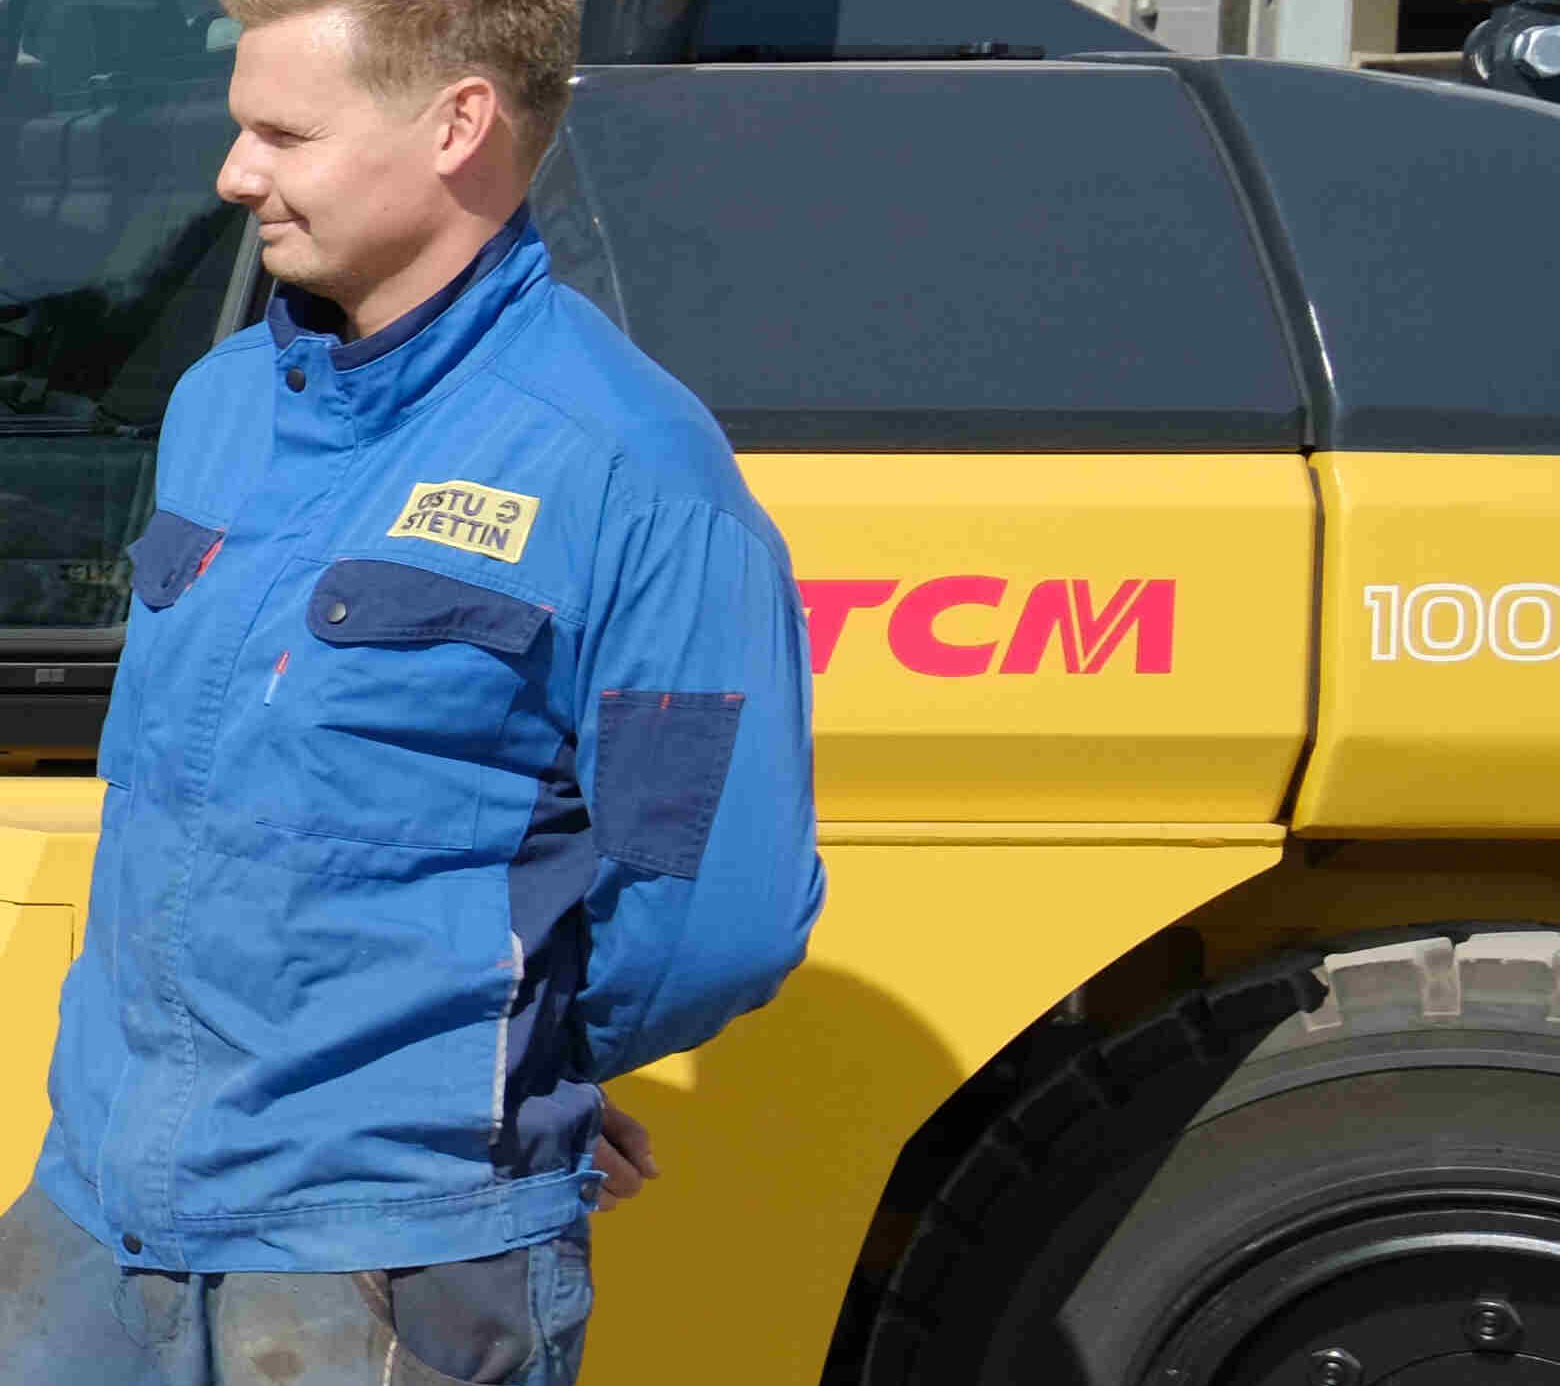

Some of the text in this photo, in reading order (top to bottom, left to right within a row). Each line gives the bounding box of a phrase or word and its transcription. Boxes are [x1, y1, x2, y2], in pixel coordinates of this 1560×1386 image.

[401, 510, 511, 550] STETTIN
[793, 574, 1177, 677] TCM
[1363, 582, 1560, 662] 100
